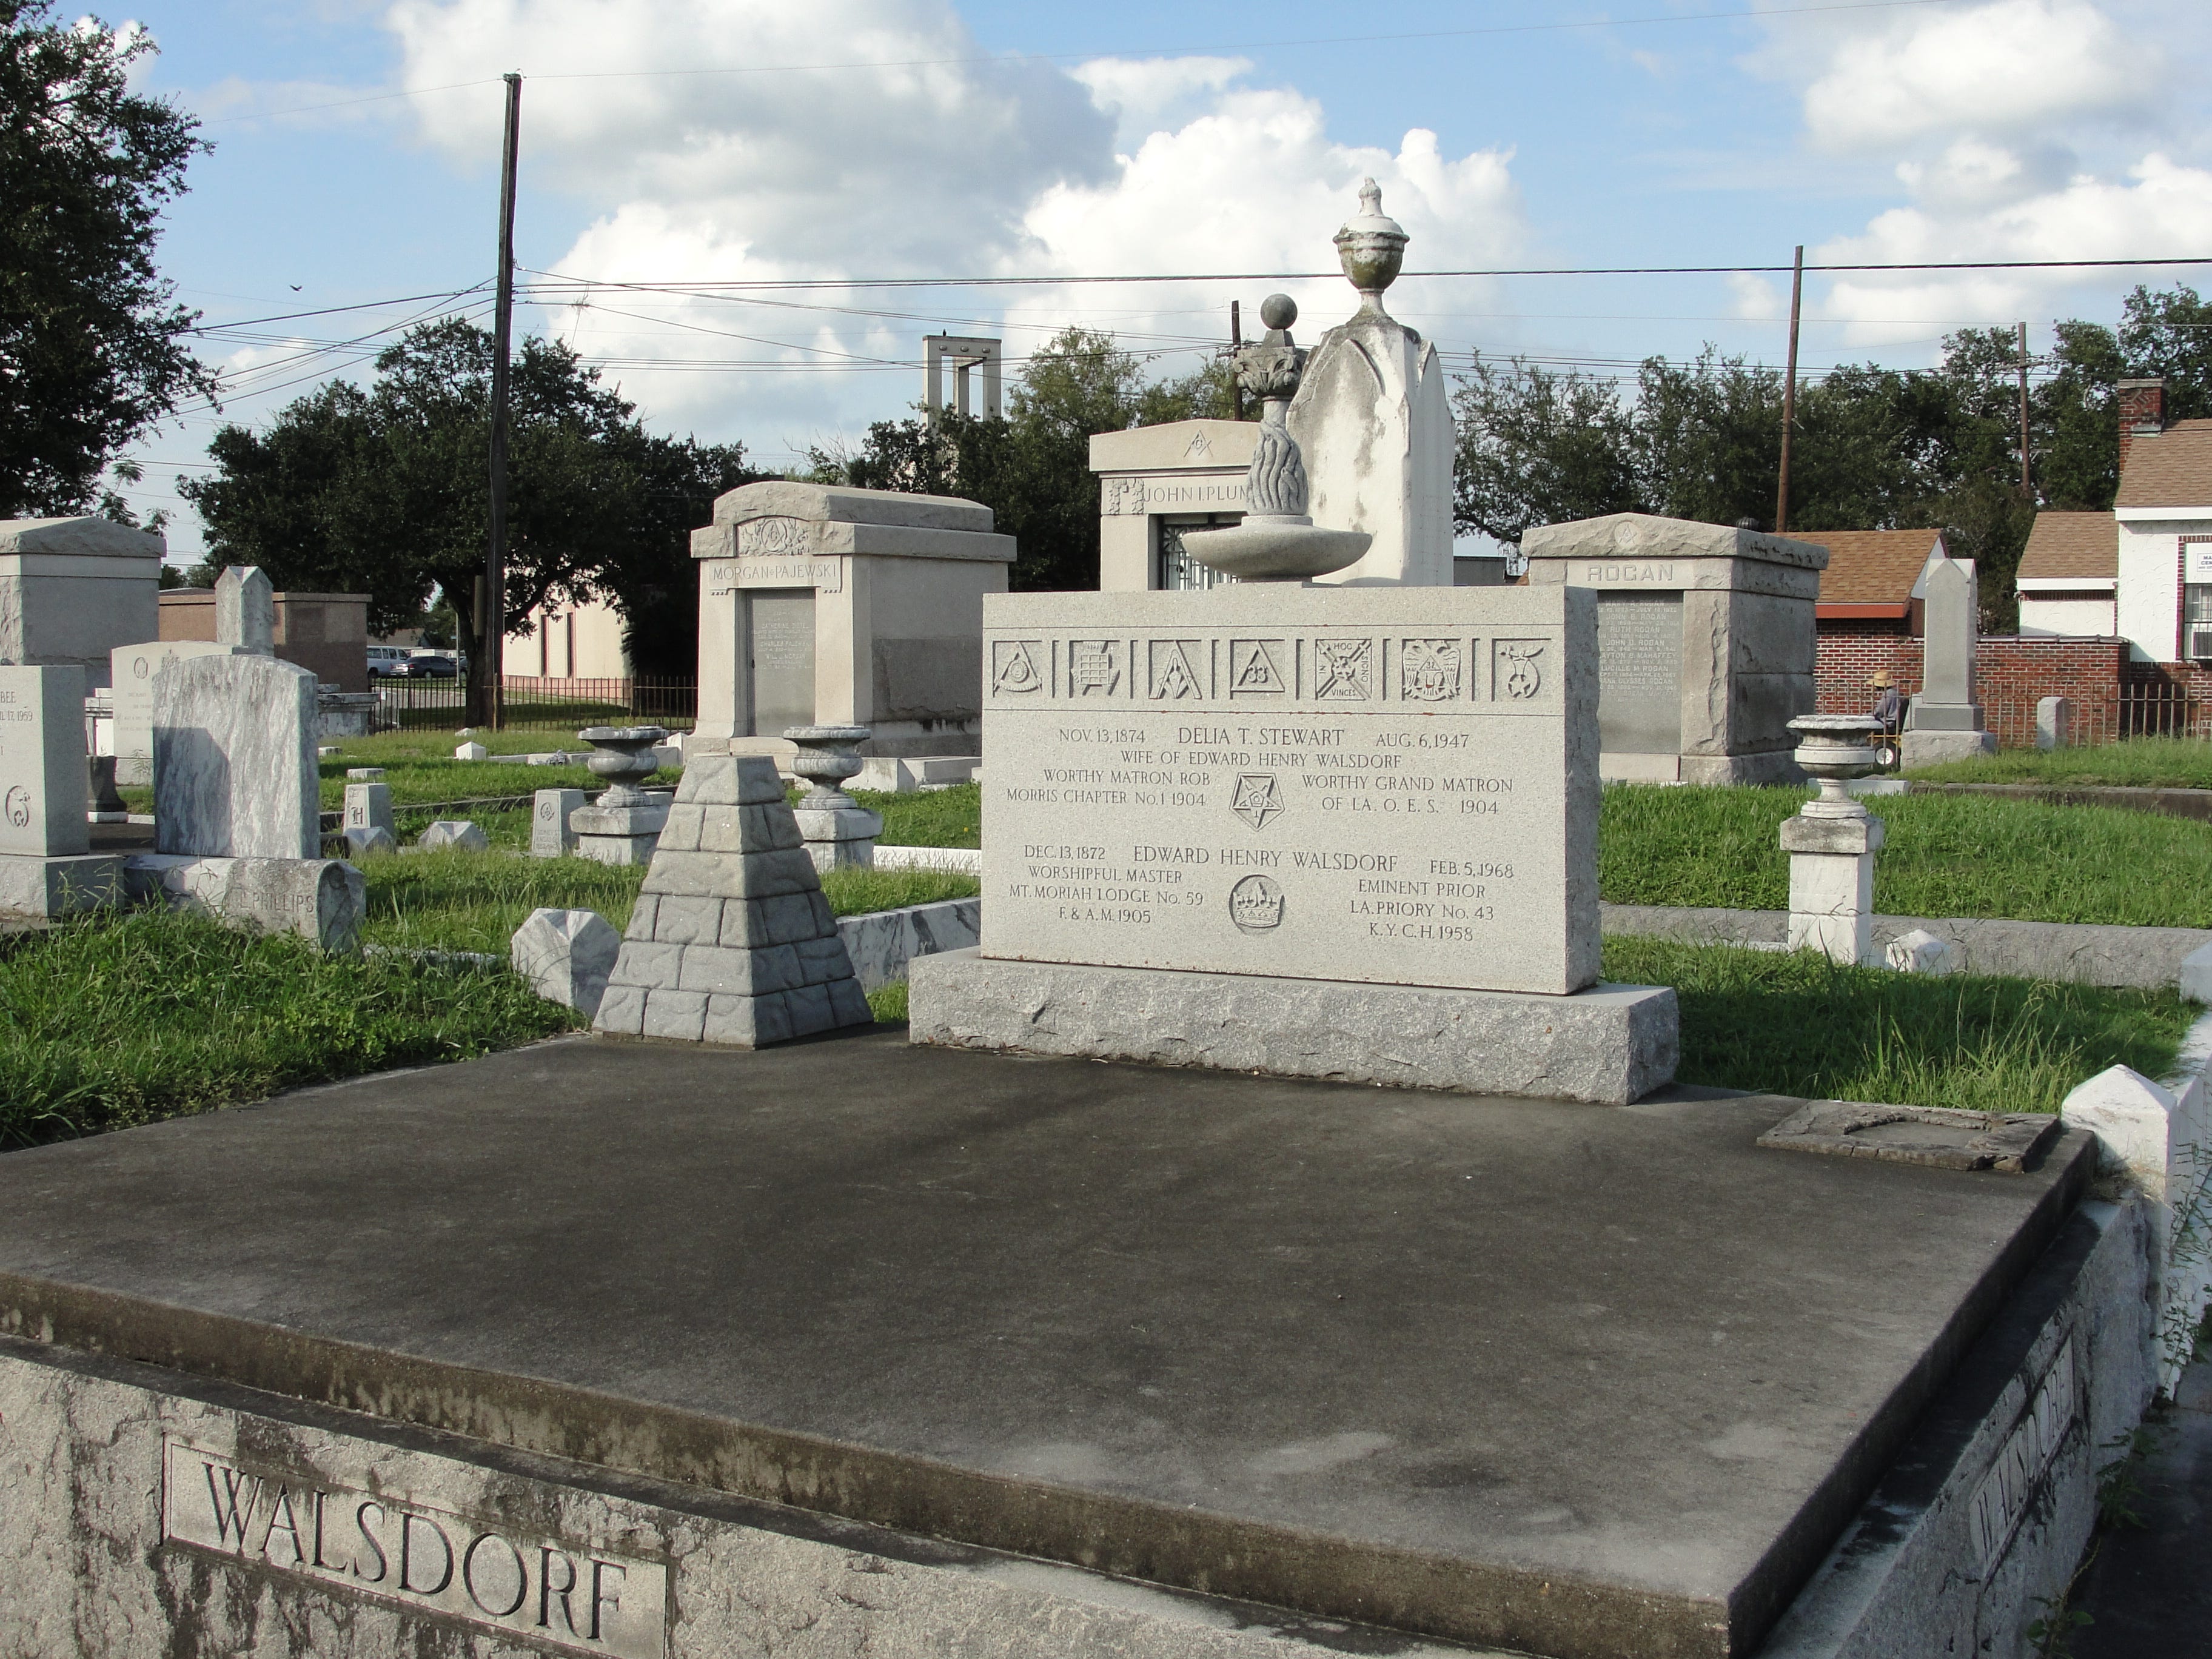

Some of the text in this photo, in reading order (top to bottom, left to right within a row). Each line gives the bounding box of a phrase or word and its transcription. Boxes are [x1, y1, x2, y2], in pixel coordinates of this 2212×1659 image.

[1144, 487, 1192, 502] JOHN
[714, 564, 836, 580] MORGAN PAJEWSKI
[1587, 564, 1673, 581] ROGAN
[1247, 666, 1267, 683] 33
[1178, 728, 1345, 746] DELIA T. STEWART
[1375, 732, 1415, 748] AUG.
[1121, 750, 1401, 768] WIFE OF EDWARD HENRY WALSDORF
[1044, 768, 1210, 786] WORTHY MATRON ROB
[1302, 774, 1513, 793] WORTHY GRAND MATRON
[1007, 788, 1058, 802] MORRIS
[1064, 789, 1127, 804] CHAPTER
[1172, 793, 1205, 806] 1904
[1322, 797, 1343, 811] OF
[1461, 800, 1499, 814] 1904
[1134, 845, 1398, 872] EDWARD HENRY WALSDORF
[1028, 865, 1183, 884] WORSHIPFUL MASTER
[1098, 888, 1151, 903] LODGE
[1186, 891, 1204, 906] 59
[1358, 879, 1486, 899] EMINENT PRIOR
[252, 891, 314, 913] PHILLIPS
[1071, 907, 1079, 920] &
[1118, 909, 1151, 923] 1905
[1474, 906, 1493, 921] 43
[201, 1461, 629, 1643] WALSDORF
